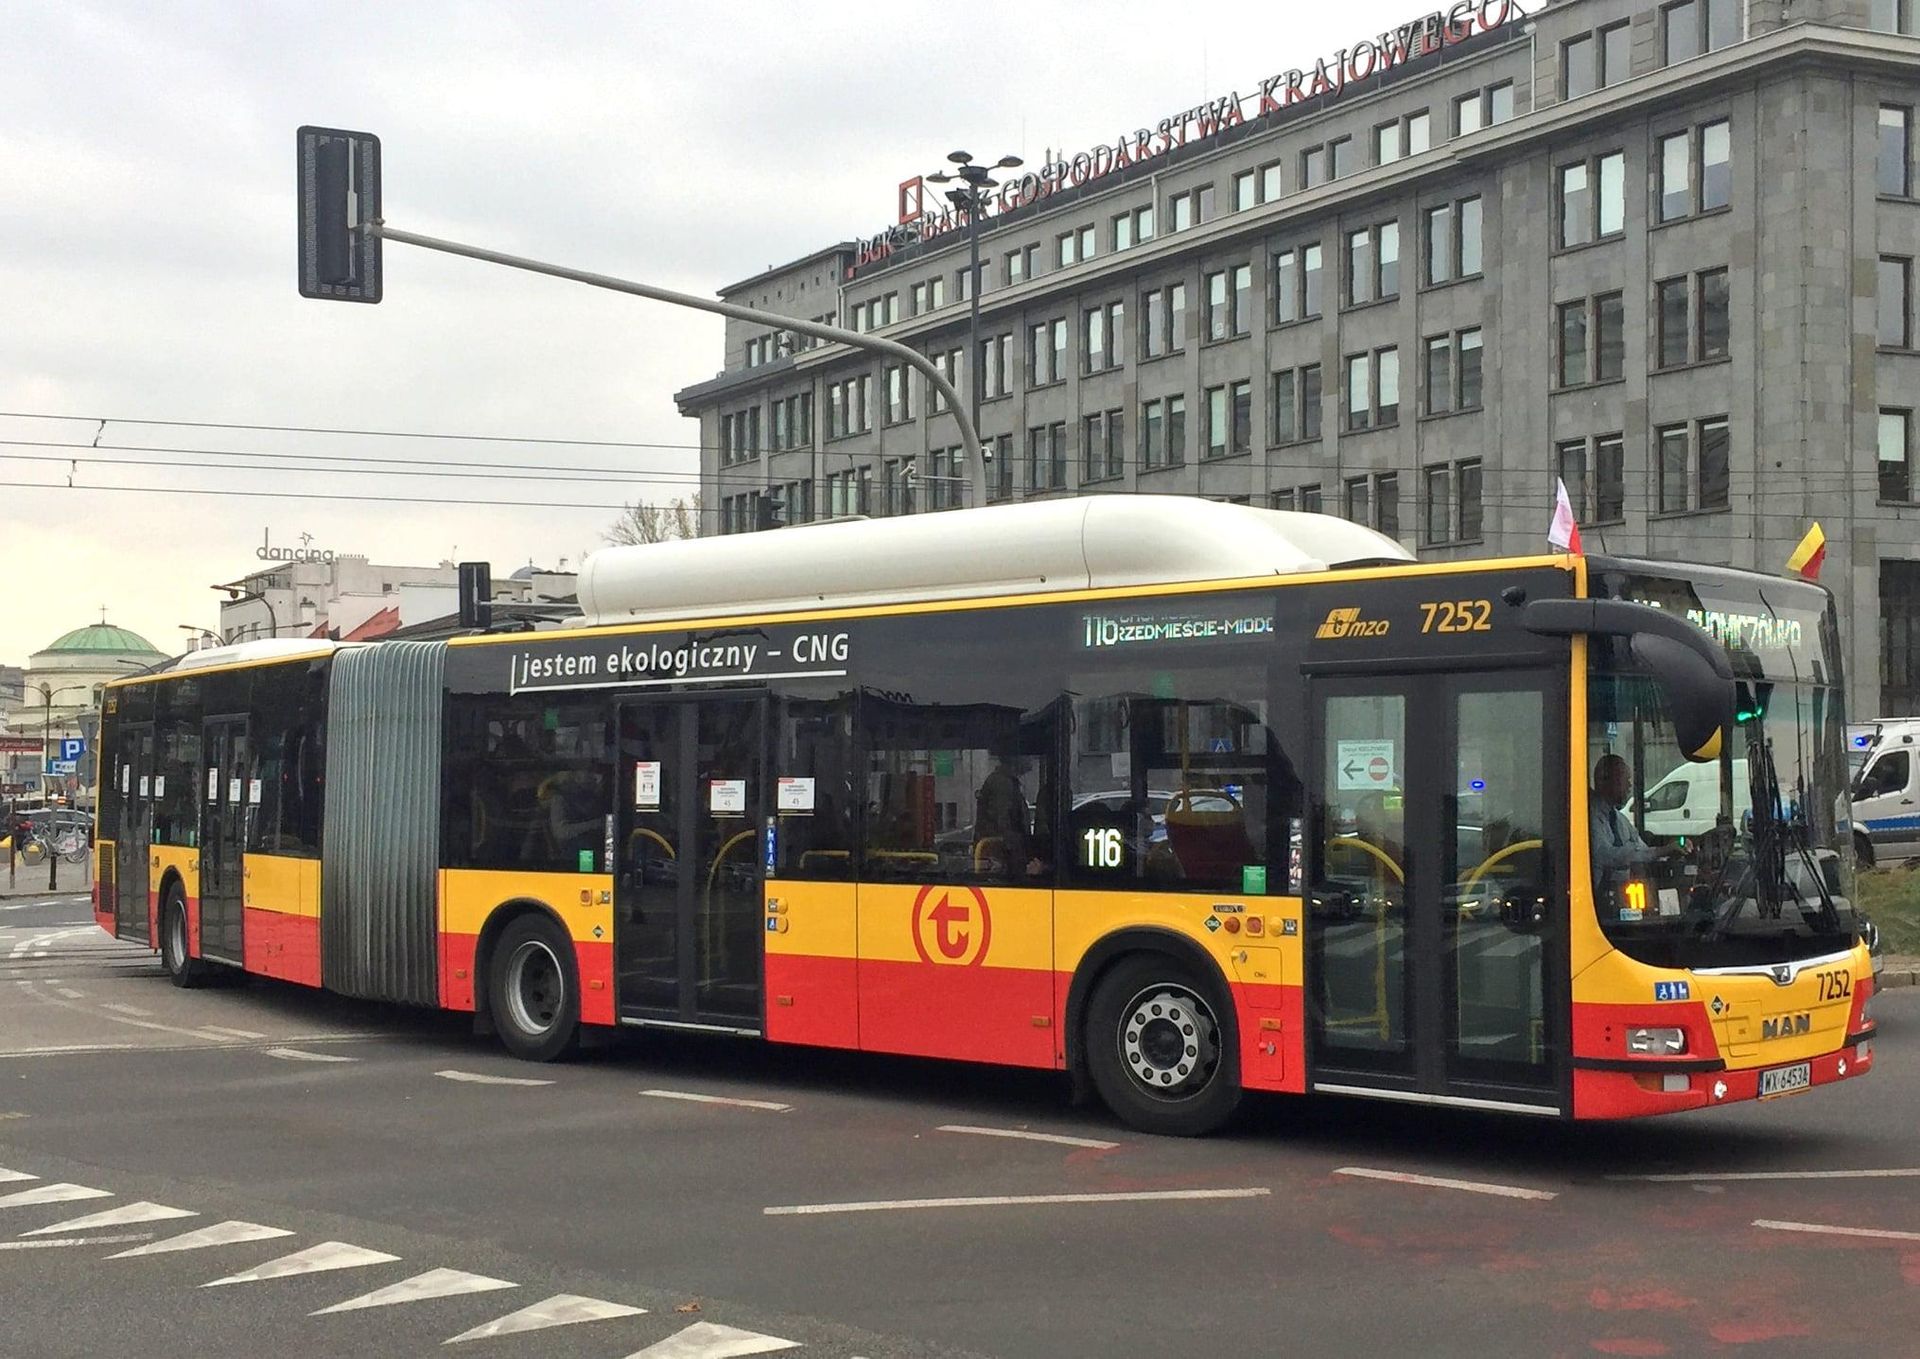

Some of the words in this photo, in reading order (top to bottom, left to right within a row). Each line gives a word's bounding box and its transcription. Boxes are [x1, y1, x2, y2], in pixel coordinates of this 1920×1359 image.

[999, 91, 1245, 214] GOSPODARSTWA
[1258, 0, 1510, 117] KRAJOWEGO
[857, 229, 896, 267] BGK
[256, 527, 334, 561] dancing
[1420, 600, 1492, 633] 7252
[521, 653, 597, 685] jestem
[607, 641, 757, 676] ekologiczny
[792, 633, 849, 663] CNG
[65, 741, 80, 759] P
[1084, 828, 1122, 867] 116
[1817, 969, 1851, 1002] 7252
[1762, 1012, 1811, 1041] MAN
[1765, 1071, 1779, 1093] WX
[1780, 1065, 1808, 1090] 6453A
